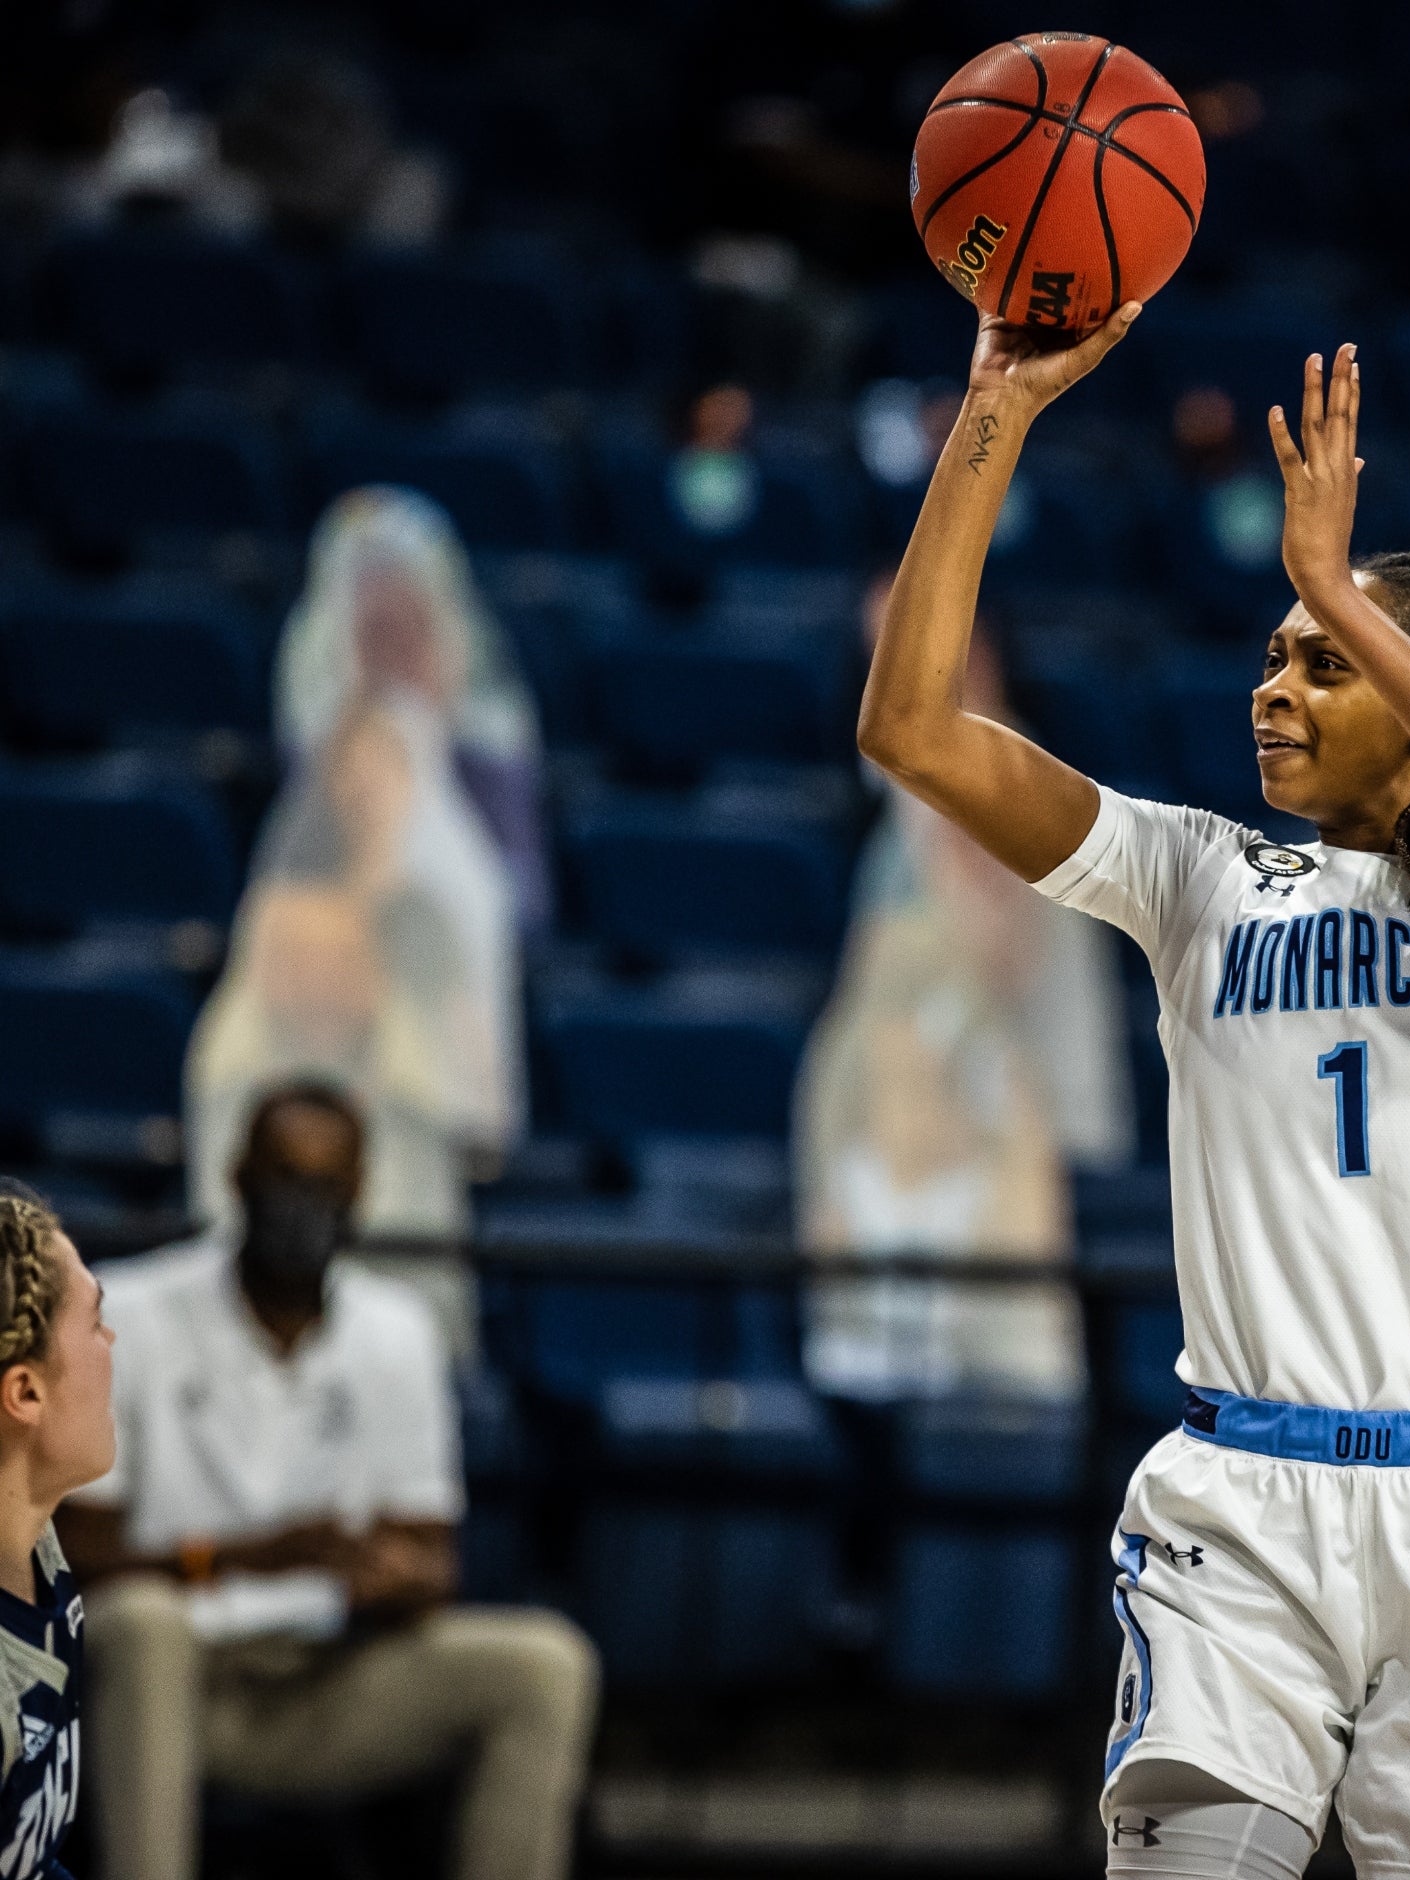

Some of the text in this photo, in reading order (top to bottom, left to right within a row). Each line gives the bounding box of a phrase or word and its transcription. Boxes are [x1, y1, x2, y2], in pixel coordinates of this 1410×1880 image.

[1026, 271, 1075, 328] CAA
[1317, 1041, 1372, 1178] 1
[1335, 1426, 1391, 1460] ODU
